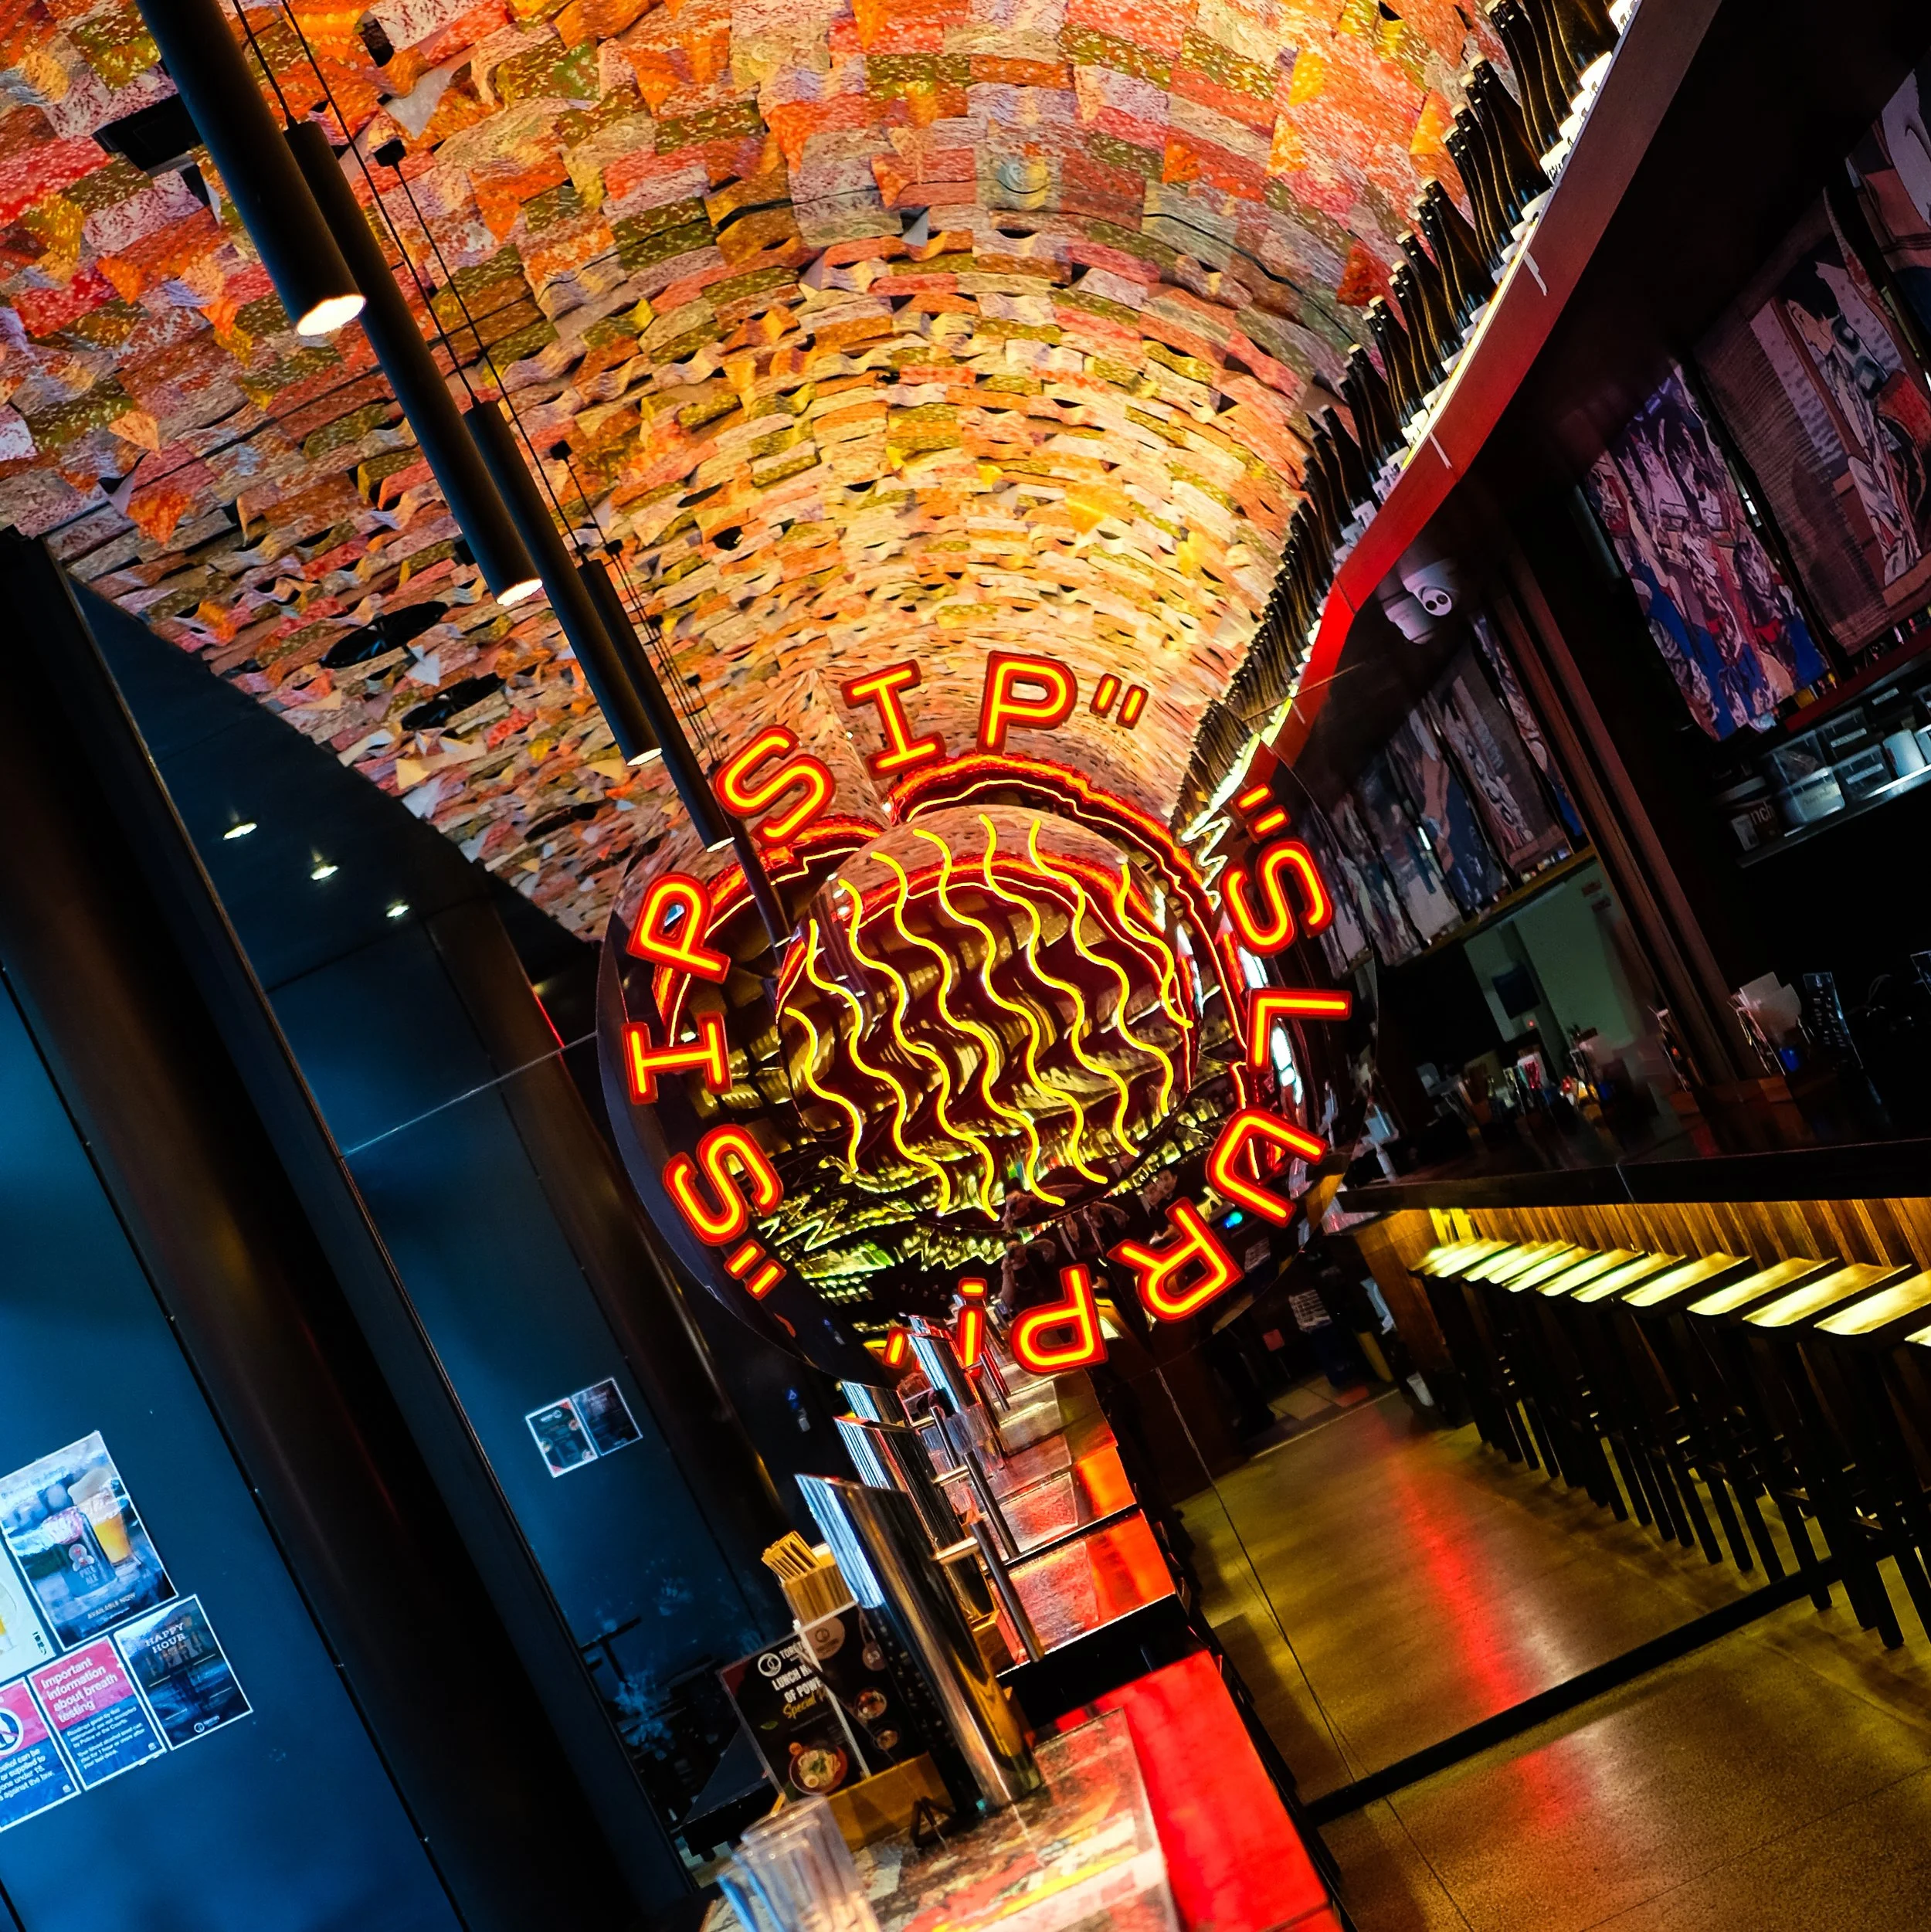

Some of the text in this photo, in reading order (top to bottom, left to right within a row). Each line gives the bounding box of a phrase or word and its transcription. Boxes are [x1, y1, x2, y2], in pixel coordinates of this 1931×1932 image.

[119, 1592, 135, 1603] NOW
[144, 1622, 183, 1647] HAPPY
[152, 1633, 186, 1654] HOUR
[41, 1657, 93, 1689] Important
[46, 1666, 106, 1700] information
[771, 1668, 801, 1691] LUNCH
[53, 1674, 118, 1712] about breath
[784, 1689, 796, 1703] OF
[796, 1676, 823, 1697] POWE
[57, 1698, 96, 1723] testing
[782, 1690, 816, 1719] Special
[8, 1757, 38, 1777] supplied
[17, 1753, 31, 1764] can
[29, 1748, 40, 1757] be
[3, 1782, 29, 1798] against
[28, 1777, 41, 1786] the
[39, 1771, 55, 1781] law.
[14, 1770, 33, 1784] under
[34, 1764, 45, 1774] 18.
